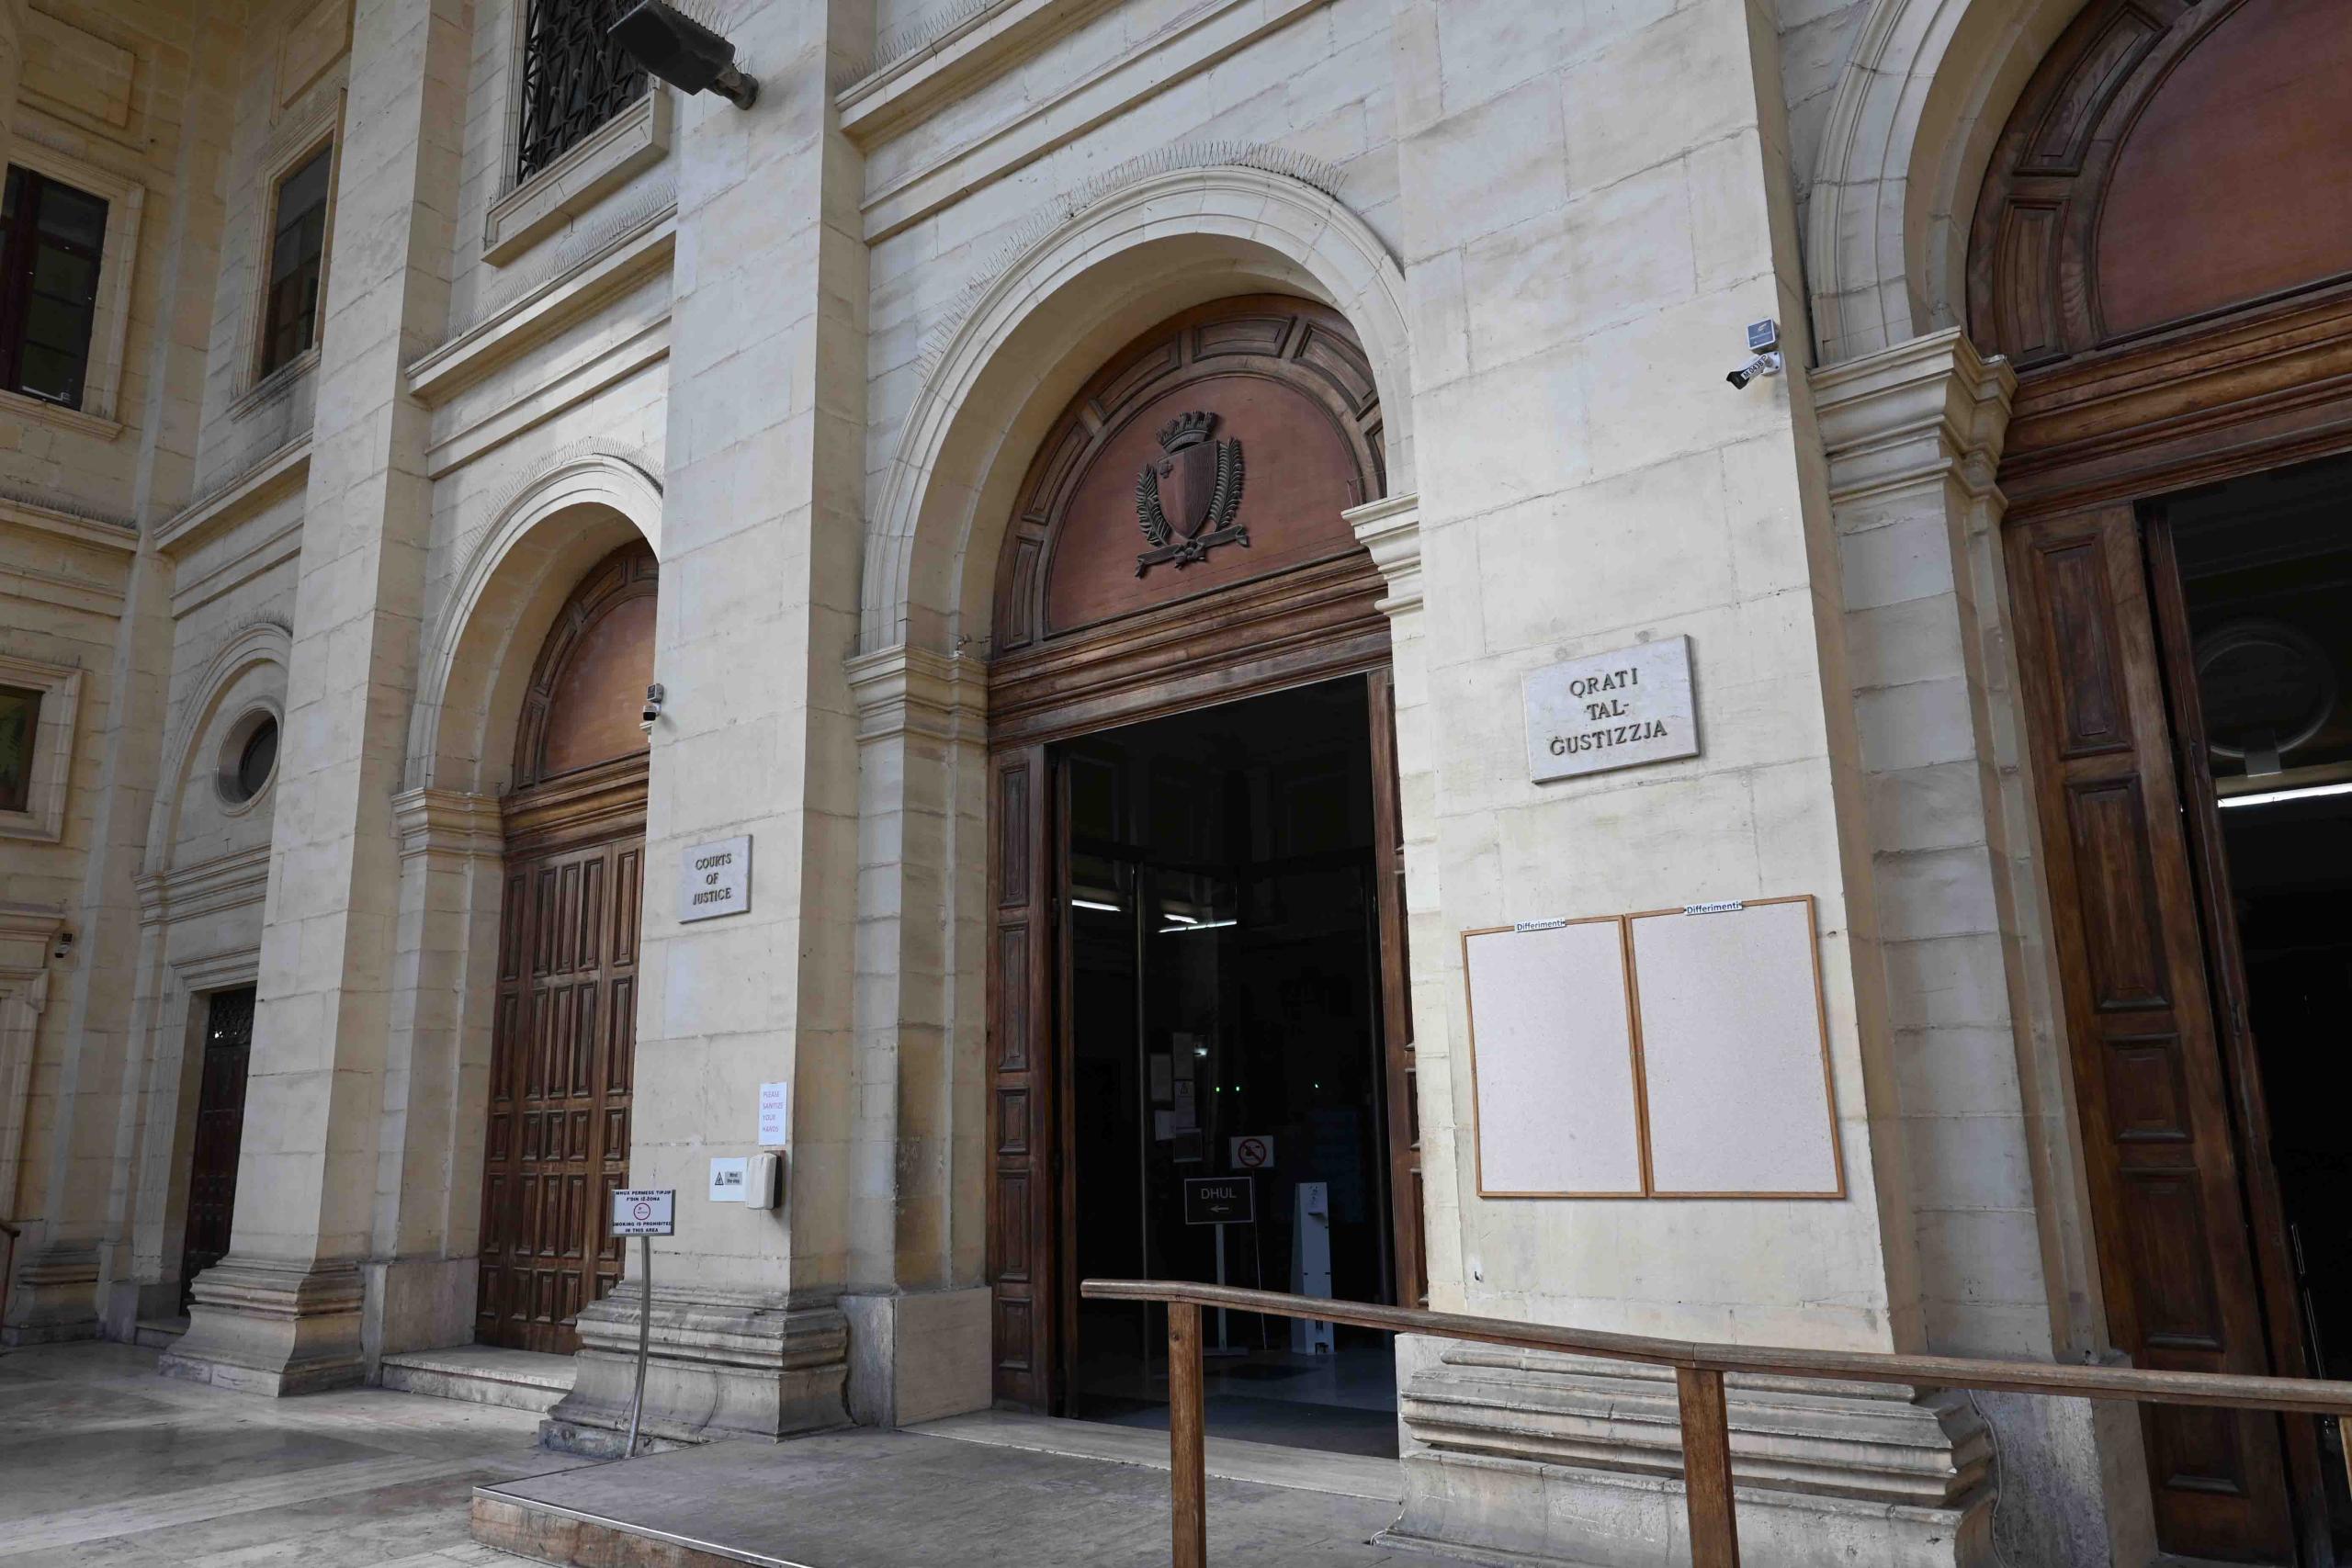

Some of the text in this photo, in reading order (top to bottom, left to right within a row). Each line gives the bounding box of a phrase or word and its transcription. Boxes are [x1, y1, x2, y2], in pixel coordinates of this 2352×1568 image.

[1569, 668, 1639, 698] QRATI
[1586, 699, 1630, 721] TAL-
[1549, 719, 1668, 756] ĠUSTIZZJA
[695, 853, 732, 871] COURTS
[706, 873, 719, 885] OF
[693, 887, 731, 906] JUSTICE
[1687, 901, 1739, 914] Differimenti
[1517, 919, 1564, 931] Differimenti
[1201, 1187, 1237, 1200] DHUL
